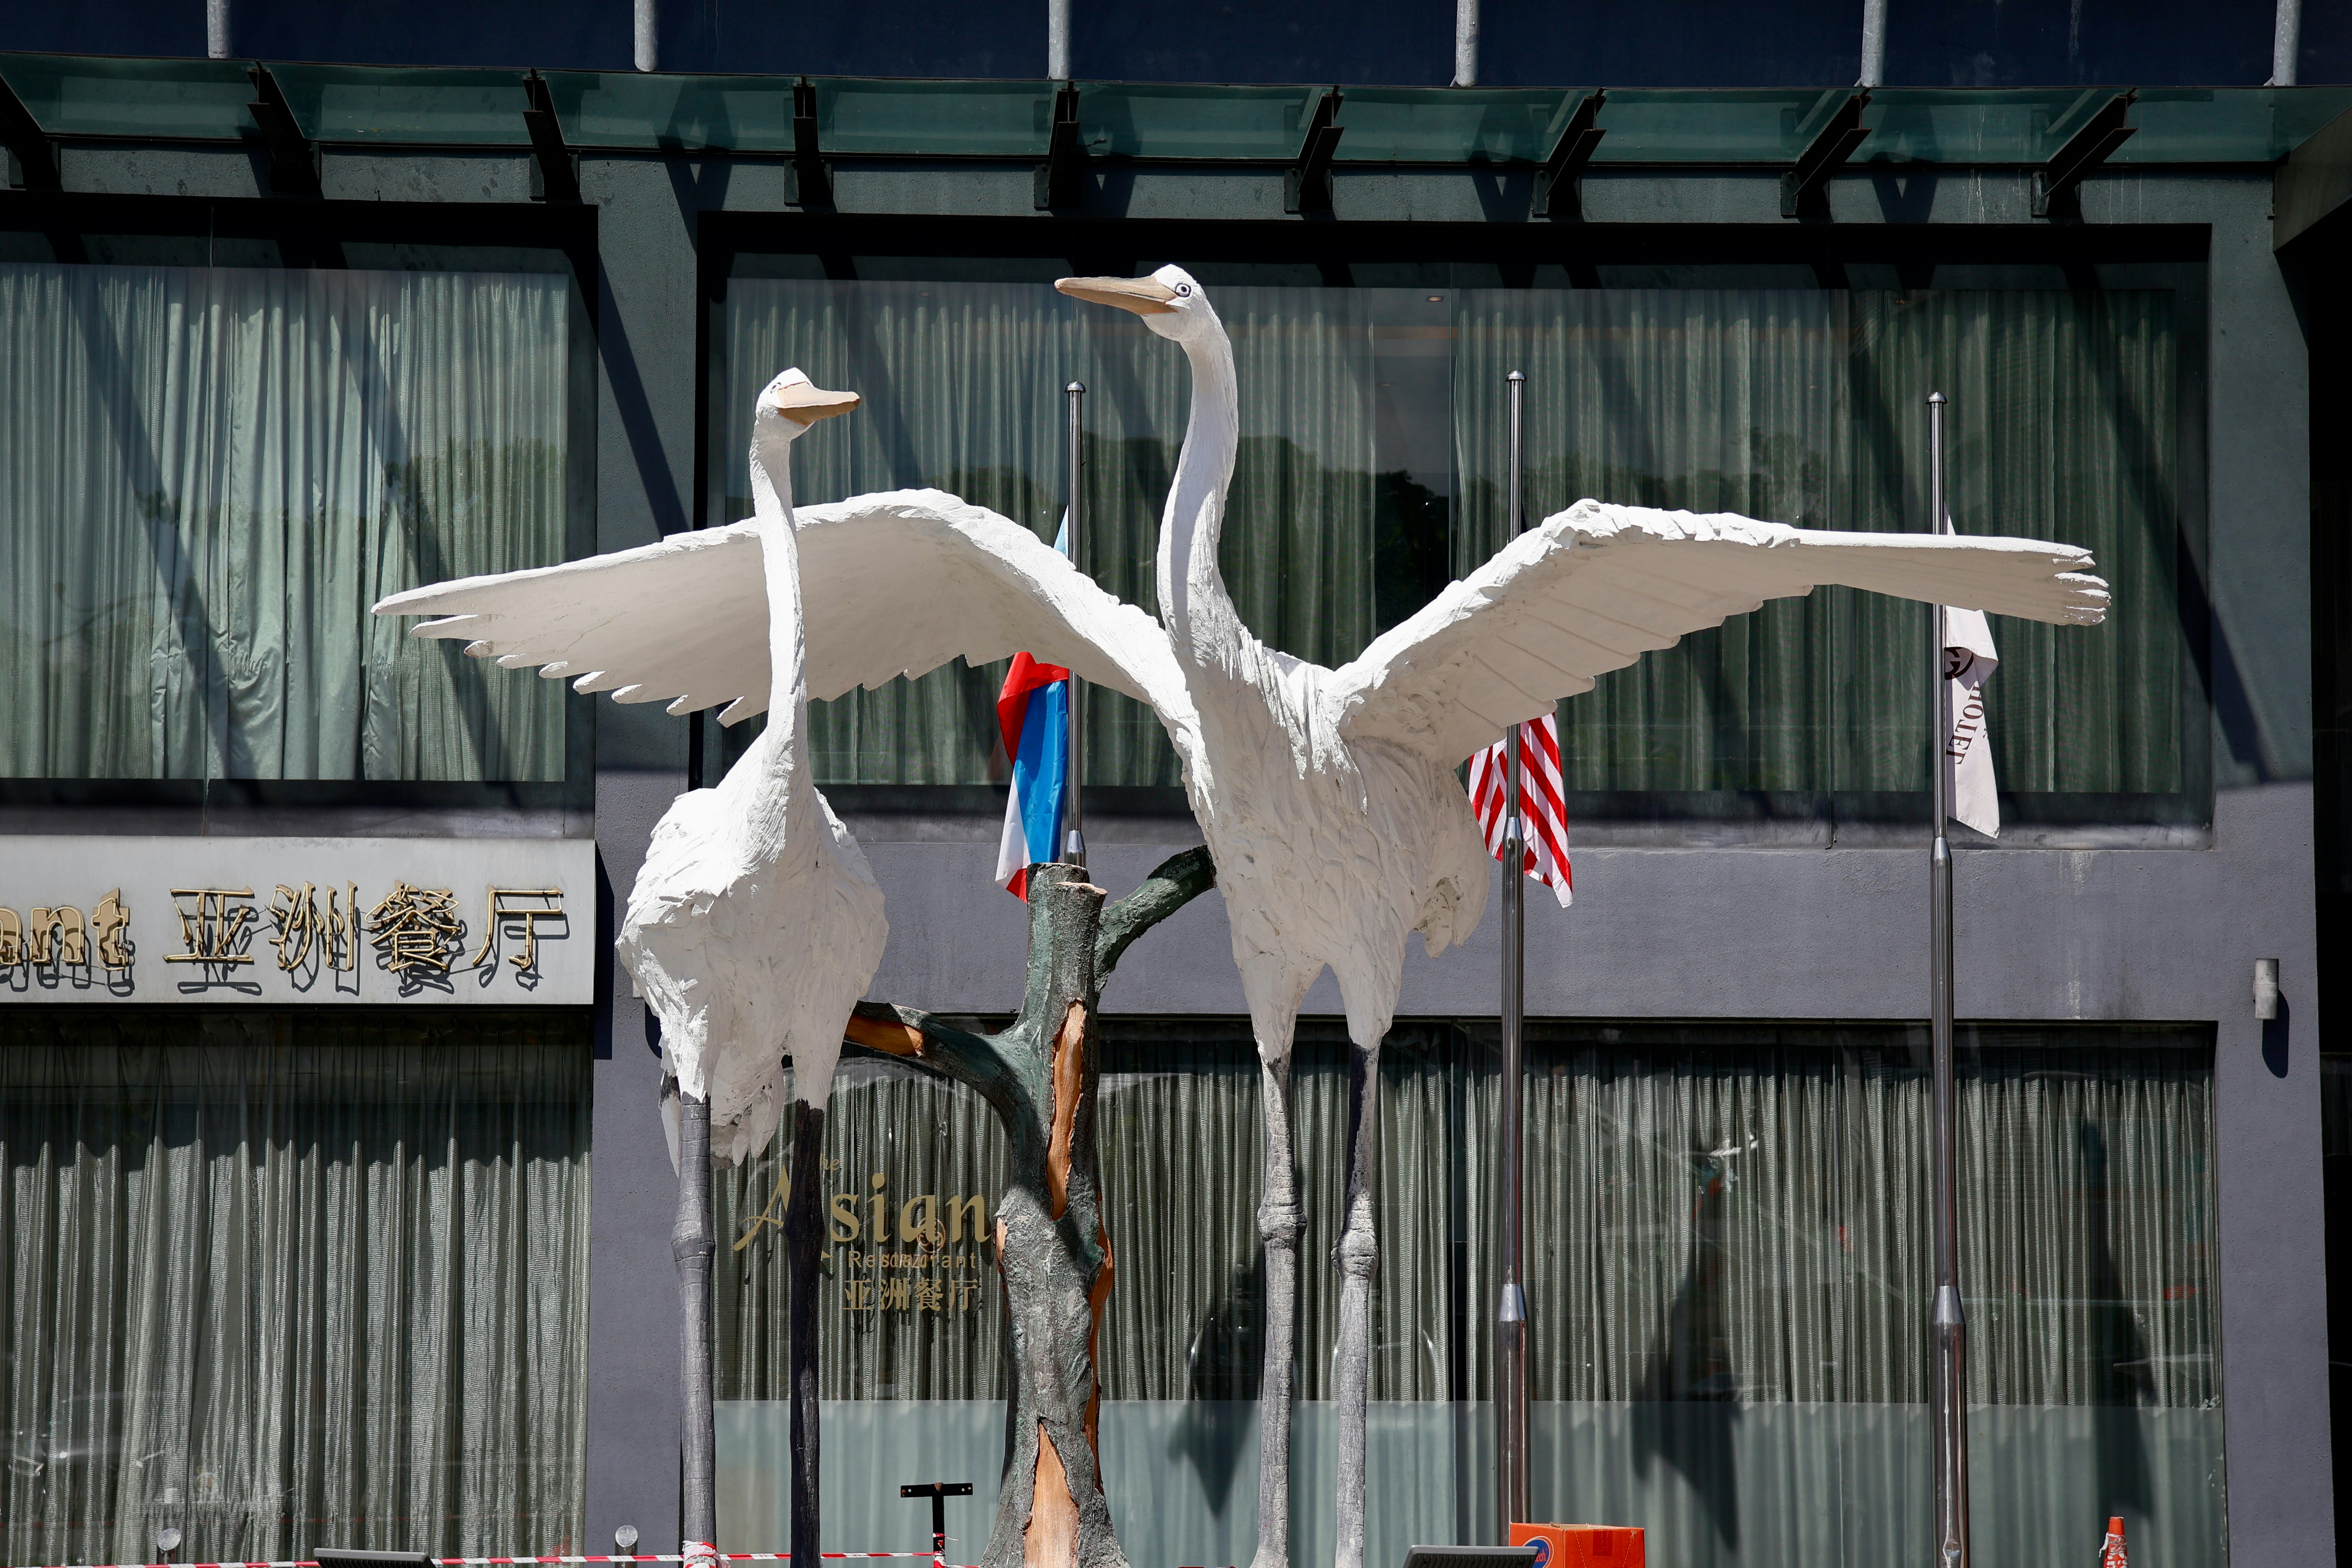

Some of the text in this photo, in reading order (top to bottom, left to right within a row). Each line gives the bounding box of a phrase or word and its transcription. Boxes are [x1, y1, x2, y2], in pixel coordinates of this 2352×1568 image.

[163, 880, 564, 973] 亚洲餐厅
[733, 1164, 992, 1258] Asian
[848, 1251, 976, 1269] Restaurant
[843, 1277, 978, 1311] 亚洲餐厅
